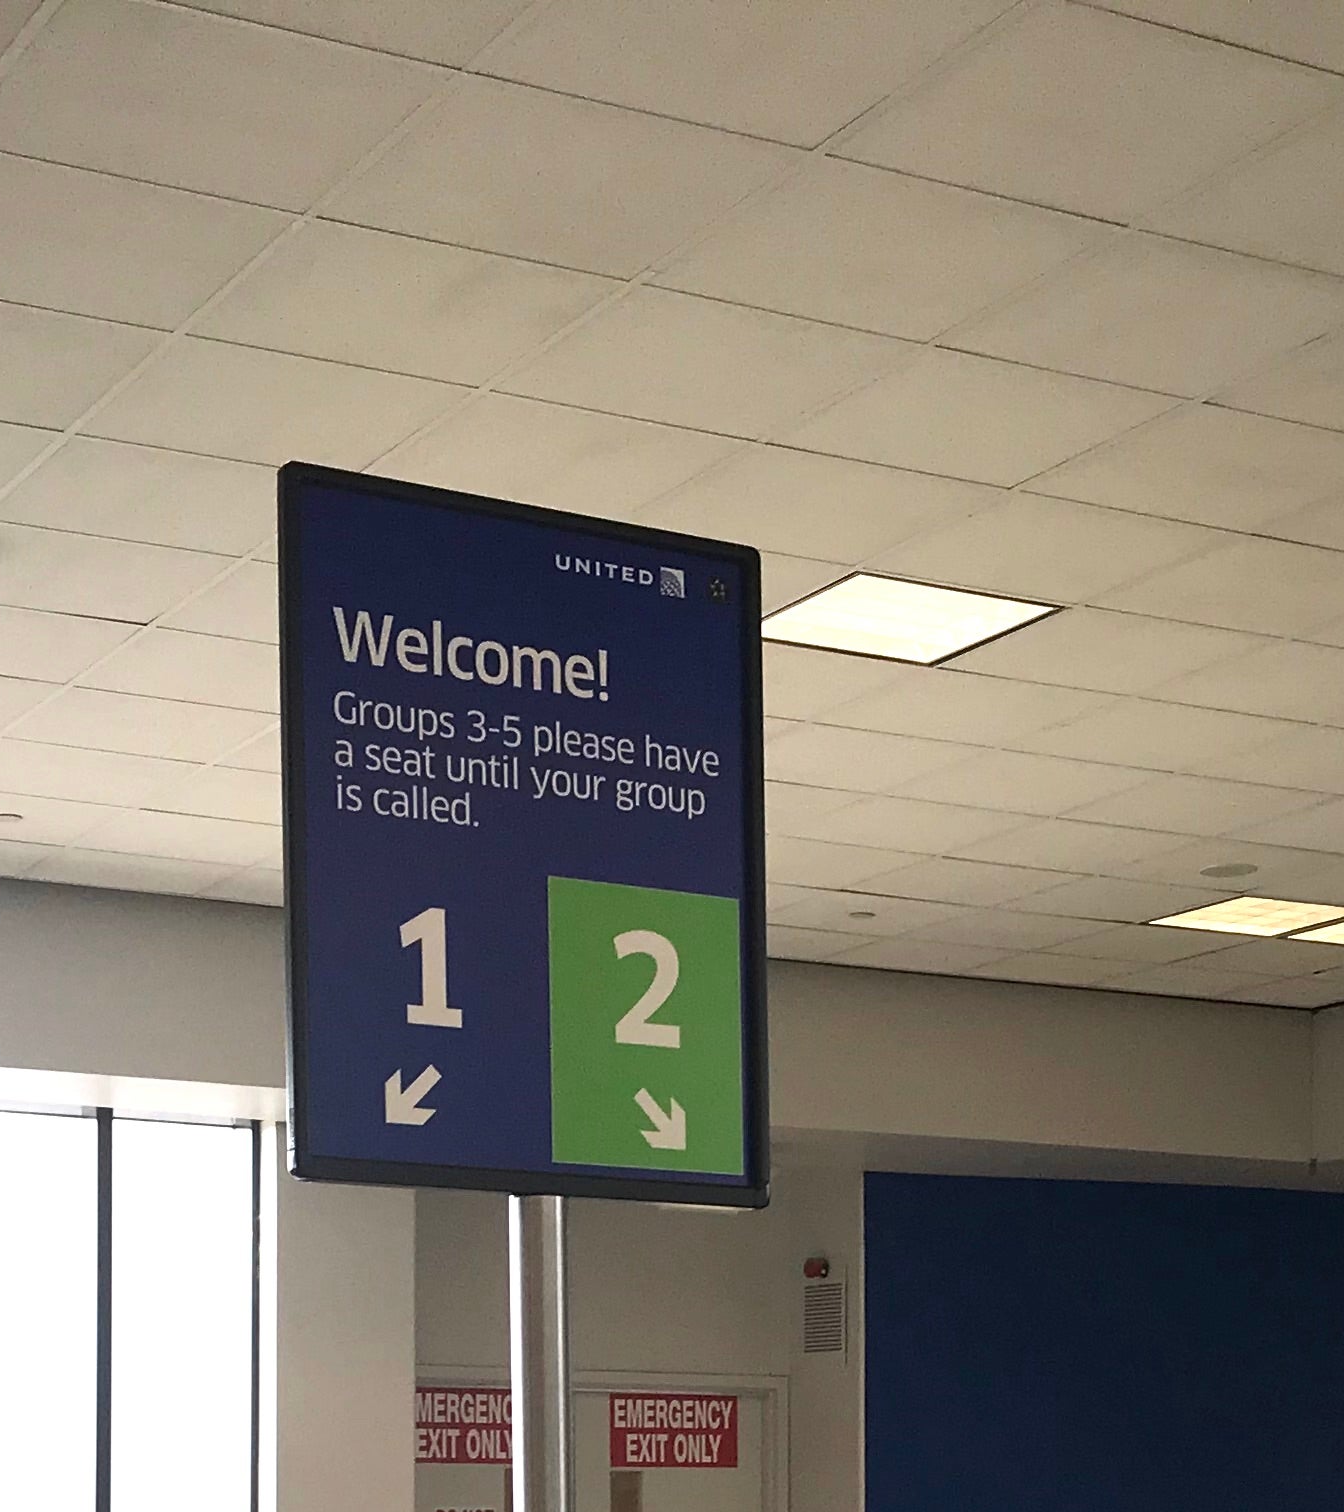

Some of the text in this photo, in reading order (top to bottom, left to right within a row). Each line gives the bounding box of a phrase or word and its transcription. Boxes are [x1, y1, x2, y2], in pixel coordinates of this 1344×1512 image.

[555, 554, 654, 586] UNITED
[332, 606, 609, 702] Welcome!
[333, 690, 720, 778] Groups 3-5 please have
[334, 739, 706, 819] a seat until your group
[336, 775, 480, 827] is called.
[399, 906, 464, 1029] 1
[613, 928, 681, 1049] 2
[416, 1393, 512, 1424] MERGENC
[614, 1399, 733, 1430] EMERGENCY
[416, 1428, 460, 1459] EXIT
[625, 1434, 721, 1464] EXIT ONLY
